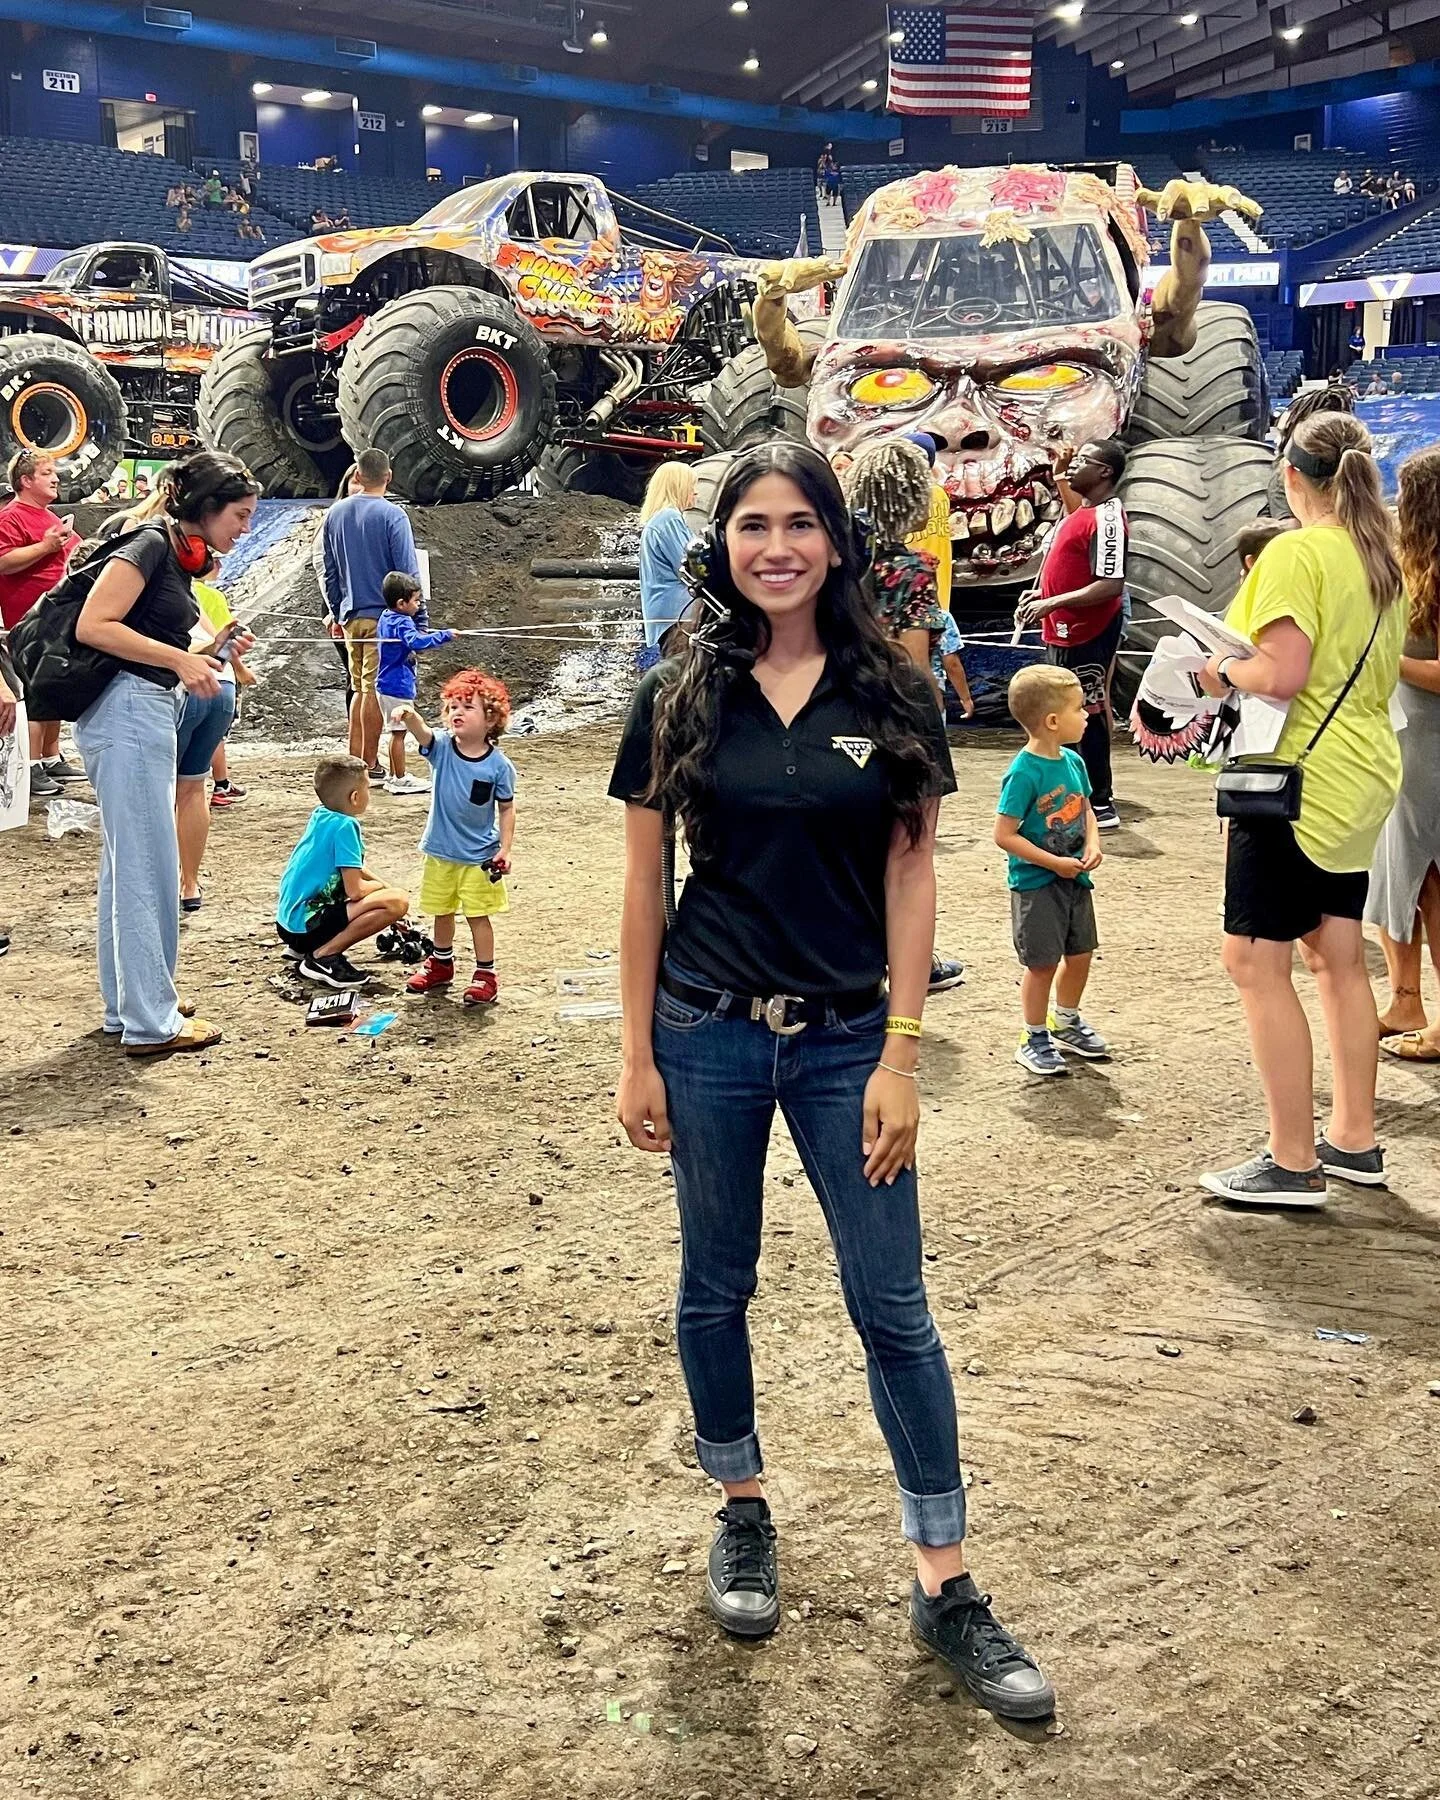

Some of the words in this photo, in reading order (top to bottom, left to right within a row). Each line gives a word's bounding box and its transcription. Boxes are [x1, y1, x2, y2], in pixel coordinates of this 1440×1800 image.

[49, 77, 73, 91] 211
[362, 117, 382, 130] 212
[985, 123, 1008, 132] 213
[496, 243, 579, 285] STONE
[517, 274, 614, 317] CRUSHER
[71, 308, 173, 343] TERMINAL
[475, 324, 518, 350] BKT
[69, 442, 101, 480] BKT
[1104, 539, 1118, 576] UNLTD
